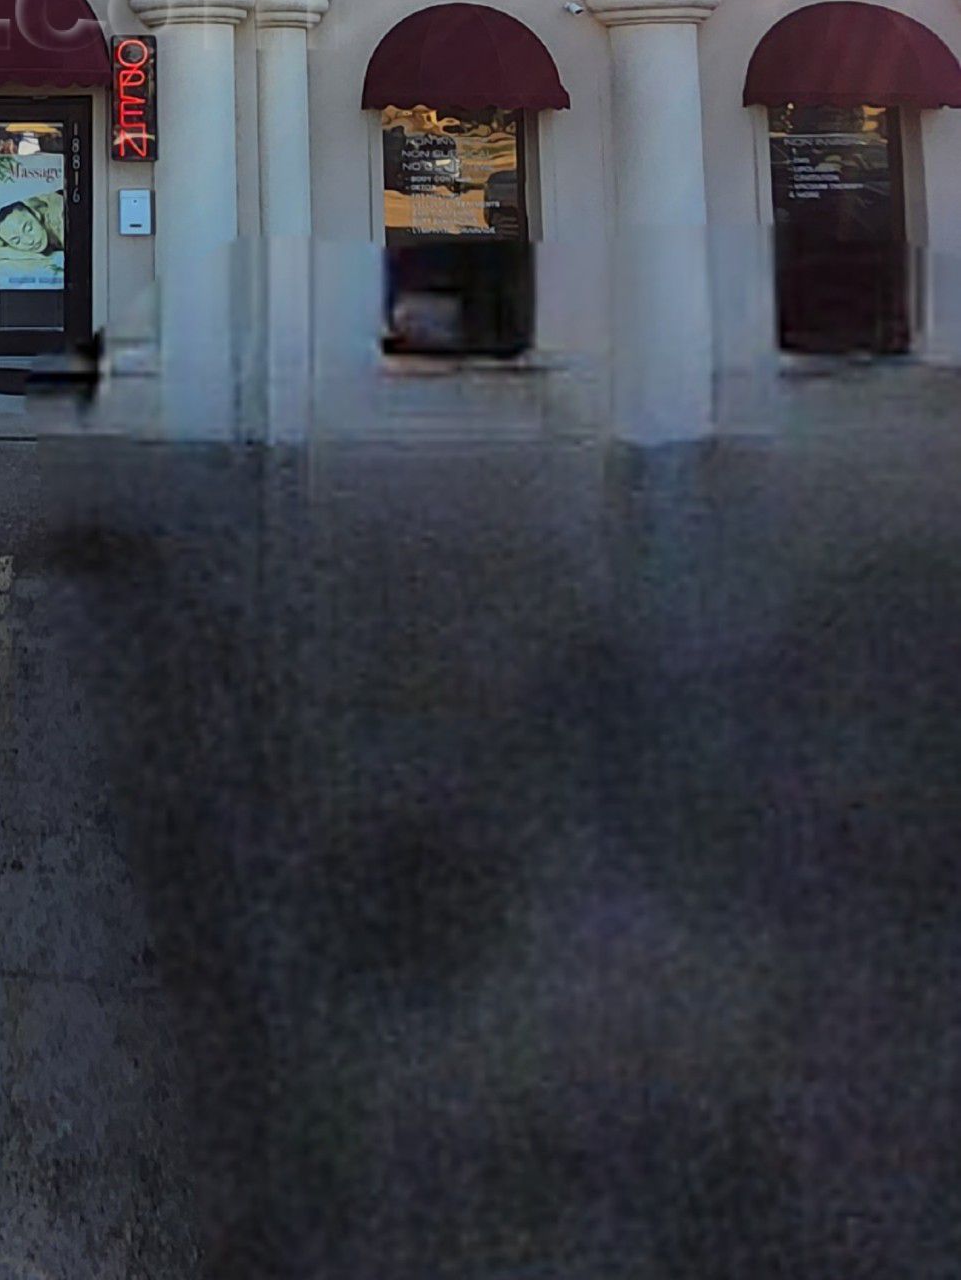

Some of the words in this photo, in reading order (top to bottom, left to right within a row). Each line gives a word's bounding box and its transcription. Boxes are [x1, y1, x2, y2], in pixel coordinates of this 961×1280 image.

[117, 39, 148, 157] OPEN
[11, 162, 63, 183] Massage
[71, 122, 81, 203] 18816
